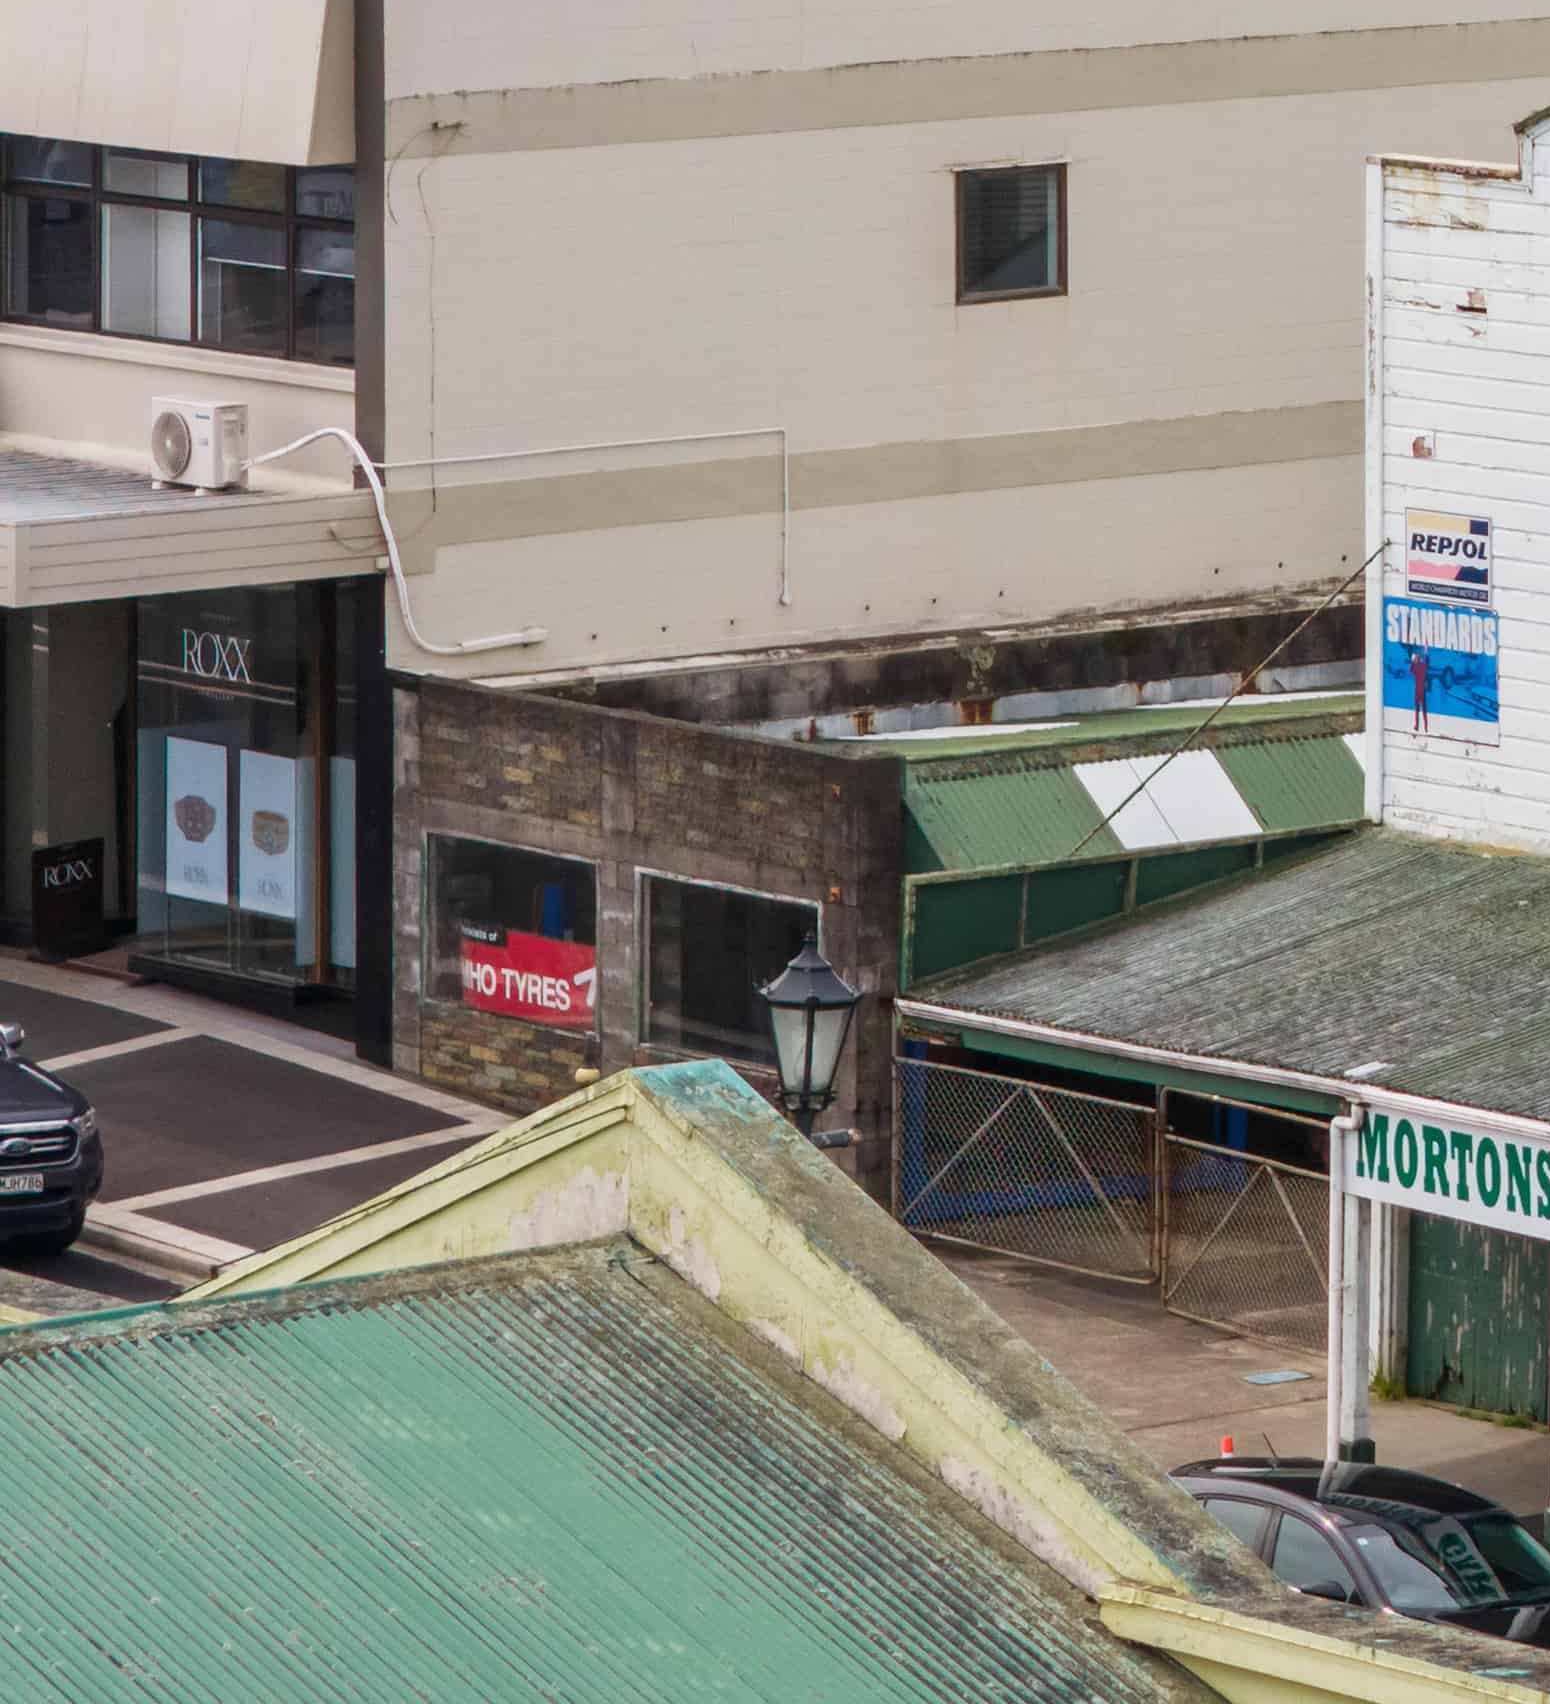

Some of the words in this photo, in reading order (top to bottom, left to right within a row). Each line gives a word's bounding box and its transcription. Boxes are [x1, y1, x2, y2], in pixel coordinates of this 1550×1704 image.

[1411, 533, 1488, 560] REPSOL
[1387, 603, 1497, 656] STANDARDS
[183, 628, 251, 683] ROXX
[43, 859, 94, 889] ROXX
[501, 968, 570, 1011] TYRES
